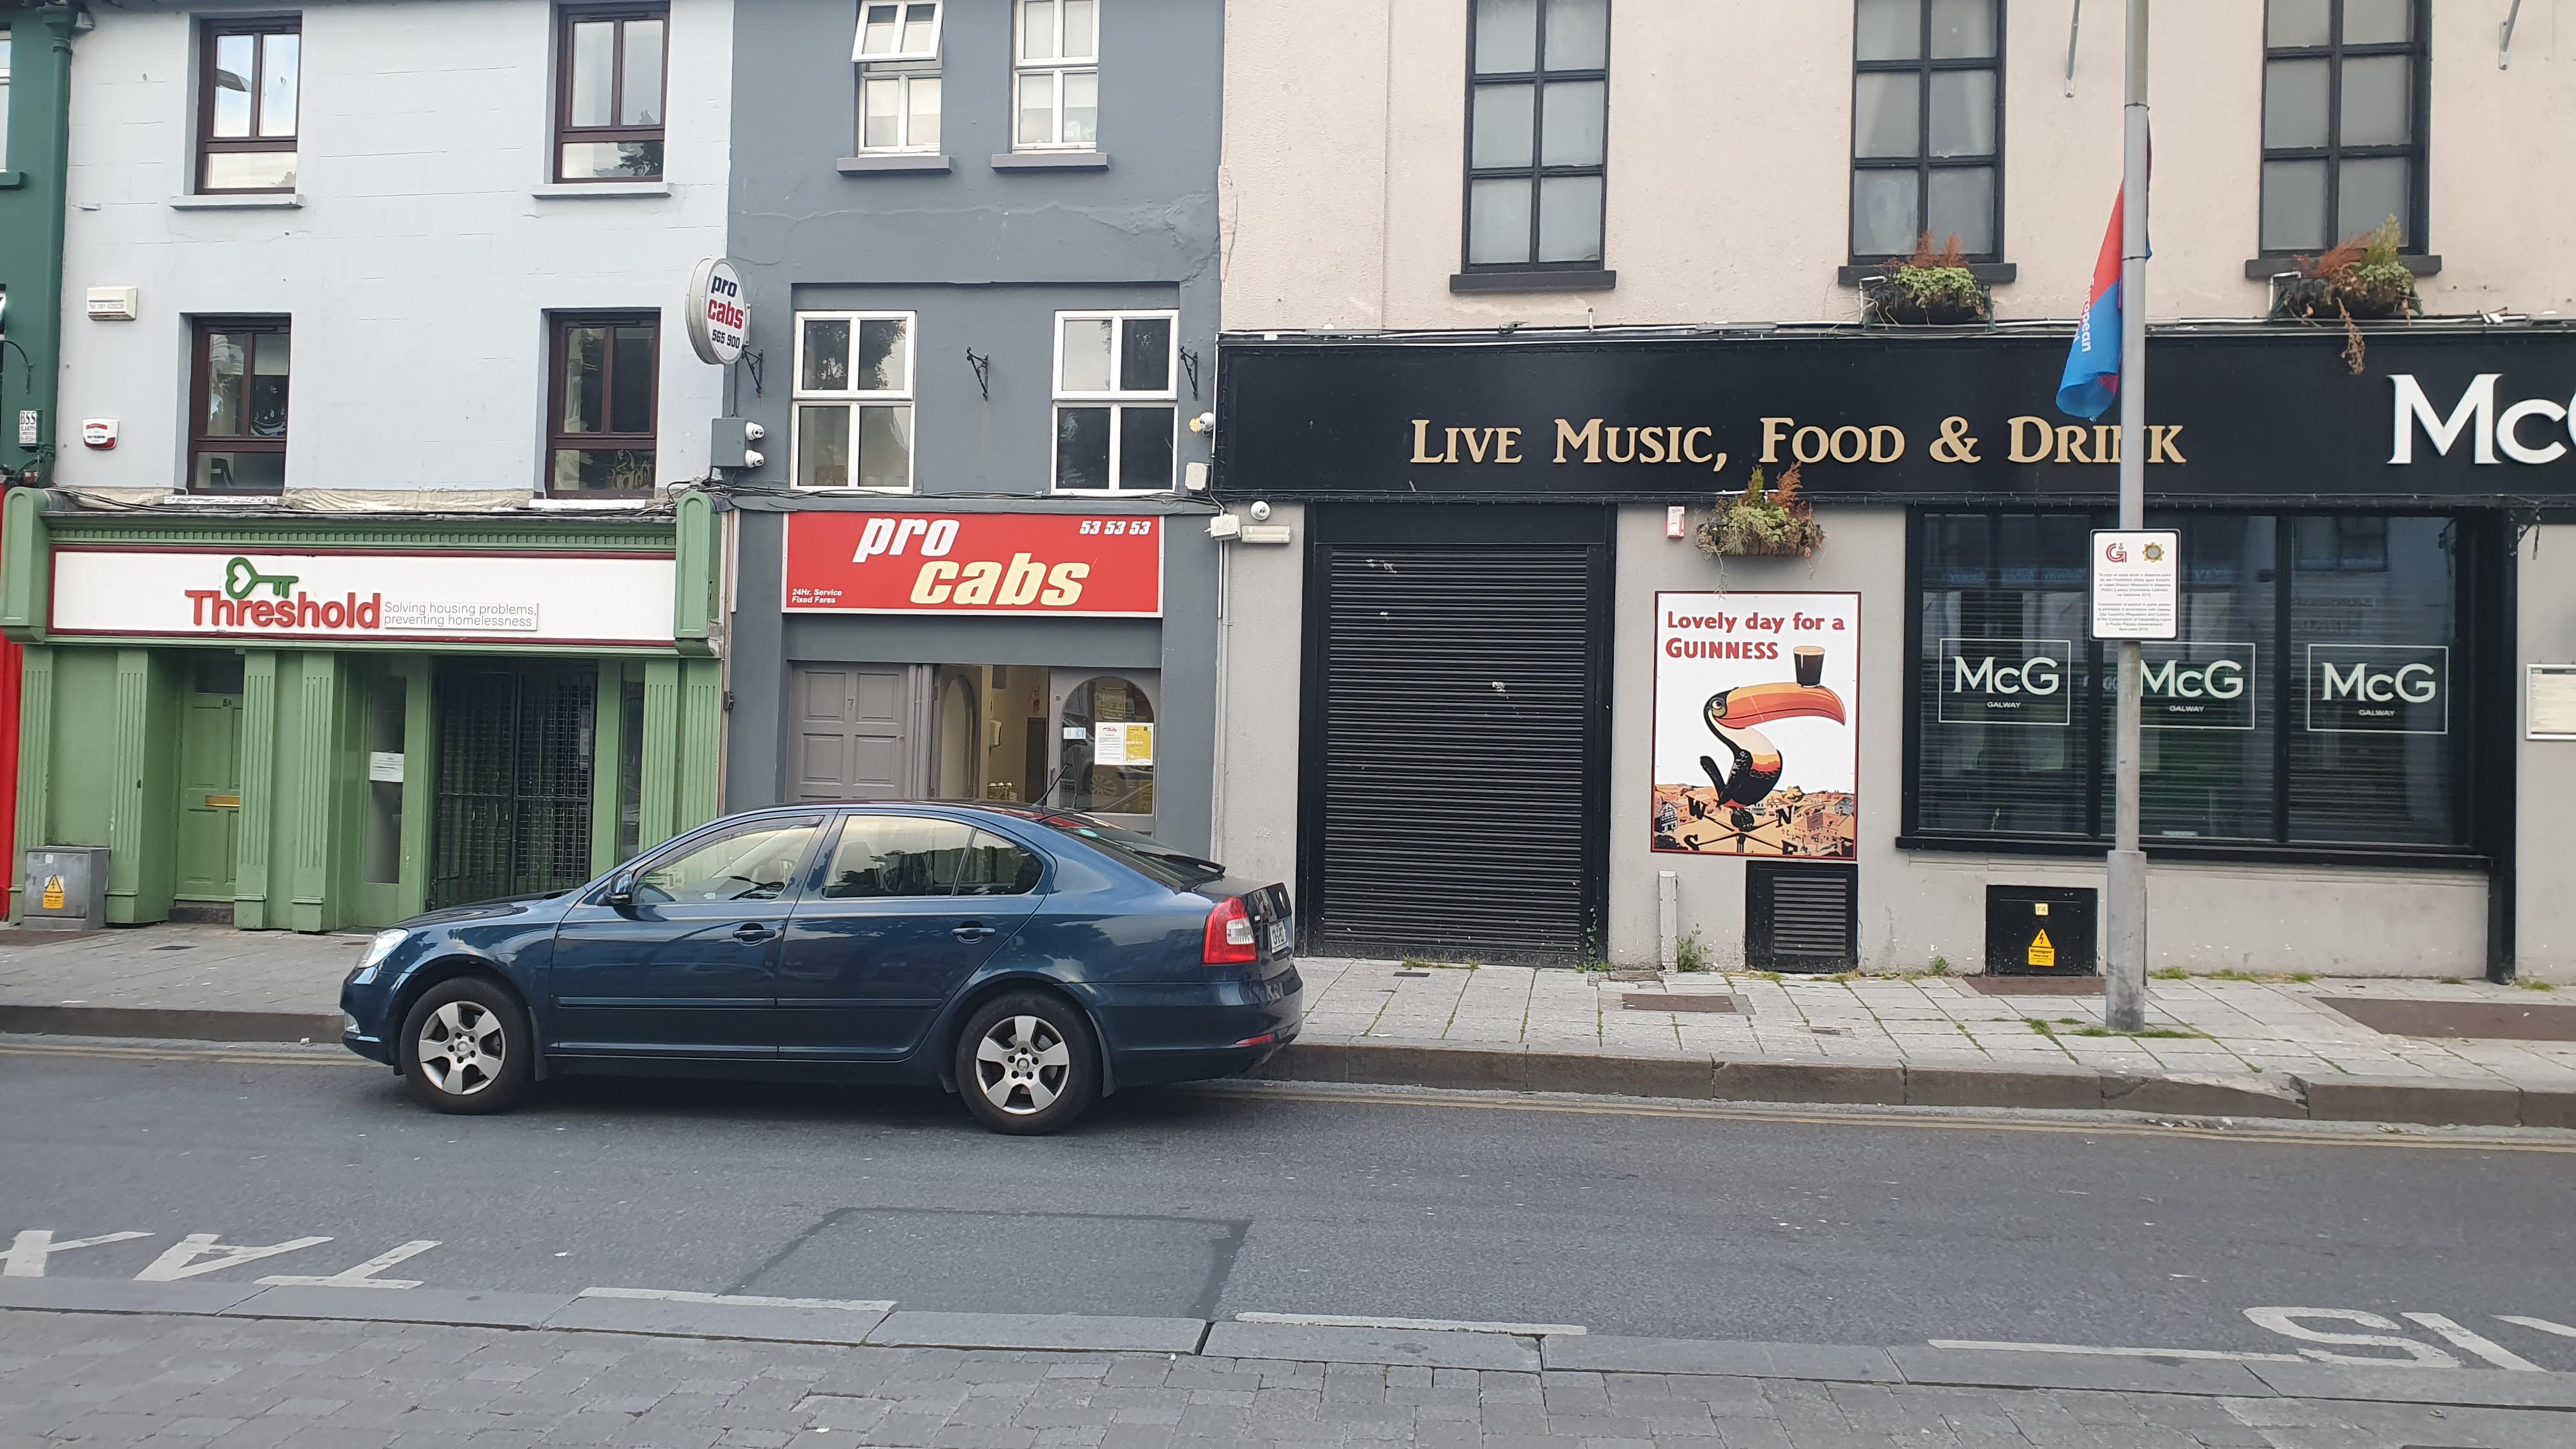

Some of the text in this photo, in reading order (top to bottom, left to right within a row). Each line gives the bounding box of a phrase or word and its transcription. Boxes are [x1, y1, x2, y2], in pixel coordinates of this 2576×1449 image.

[710, 275, 737, 298] pro
[707, 299, 744, 329] cabs
[712, 329, 740, 349] 565 900
[20, 411, 36, 425] BSS
[2386, 373, 2576, 464] Mc
[1409, 419, 1522, 463] LIVE
[1552, 418, 1727, 472] MUSIC,
[1758, 417, 1905, 463] FOOD
[1929, 416, 1981, 463] &
[1079, 521, 1151, 535] 53 53 53
[852, 518, 960, 563] pro
[910, 553, 1091, 606] cabs
[185, 590, 381, 629] Threshold
[385, 601, 537, 616] Solving housing problems,
[384, 615, 532, 627] preventing homelessness
[1667, 611, 1845, 634] Lovely day for a
[1666, 638, 1779, 659] GUINNESS
[1952, 656, 2059, 695] McG
[2140, 659, 2243, 699] McG
[2321, 662, 2436, 703] McG
[847, 698, 854, 710] 7
[1776, 804, 1793, 827] N
